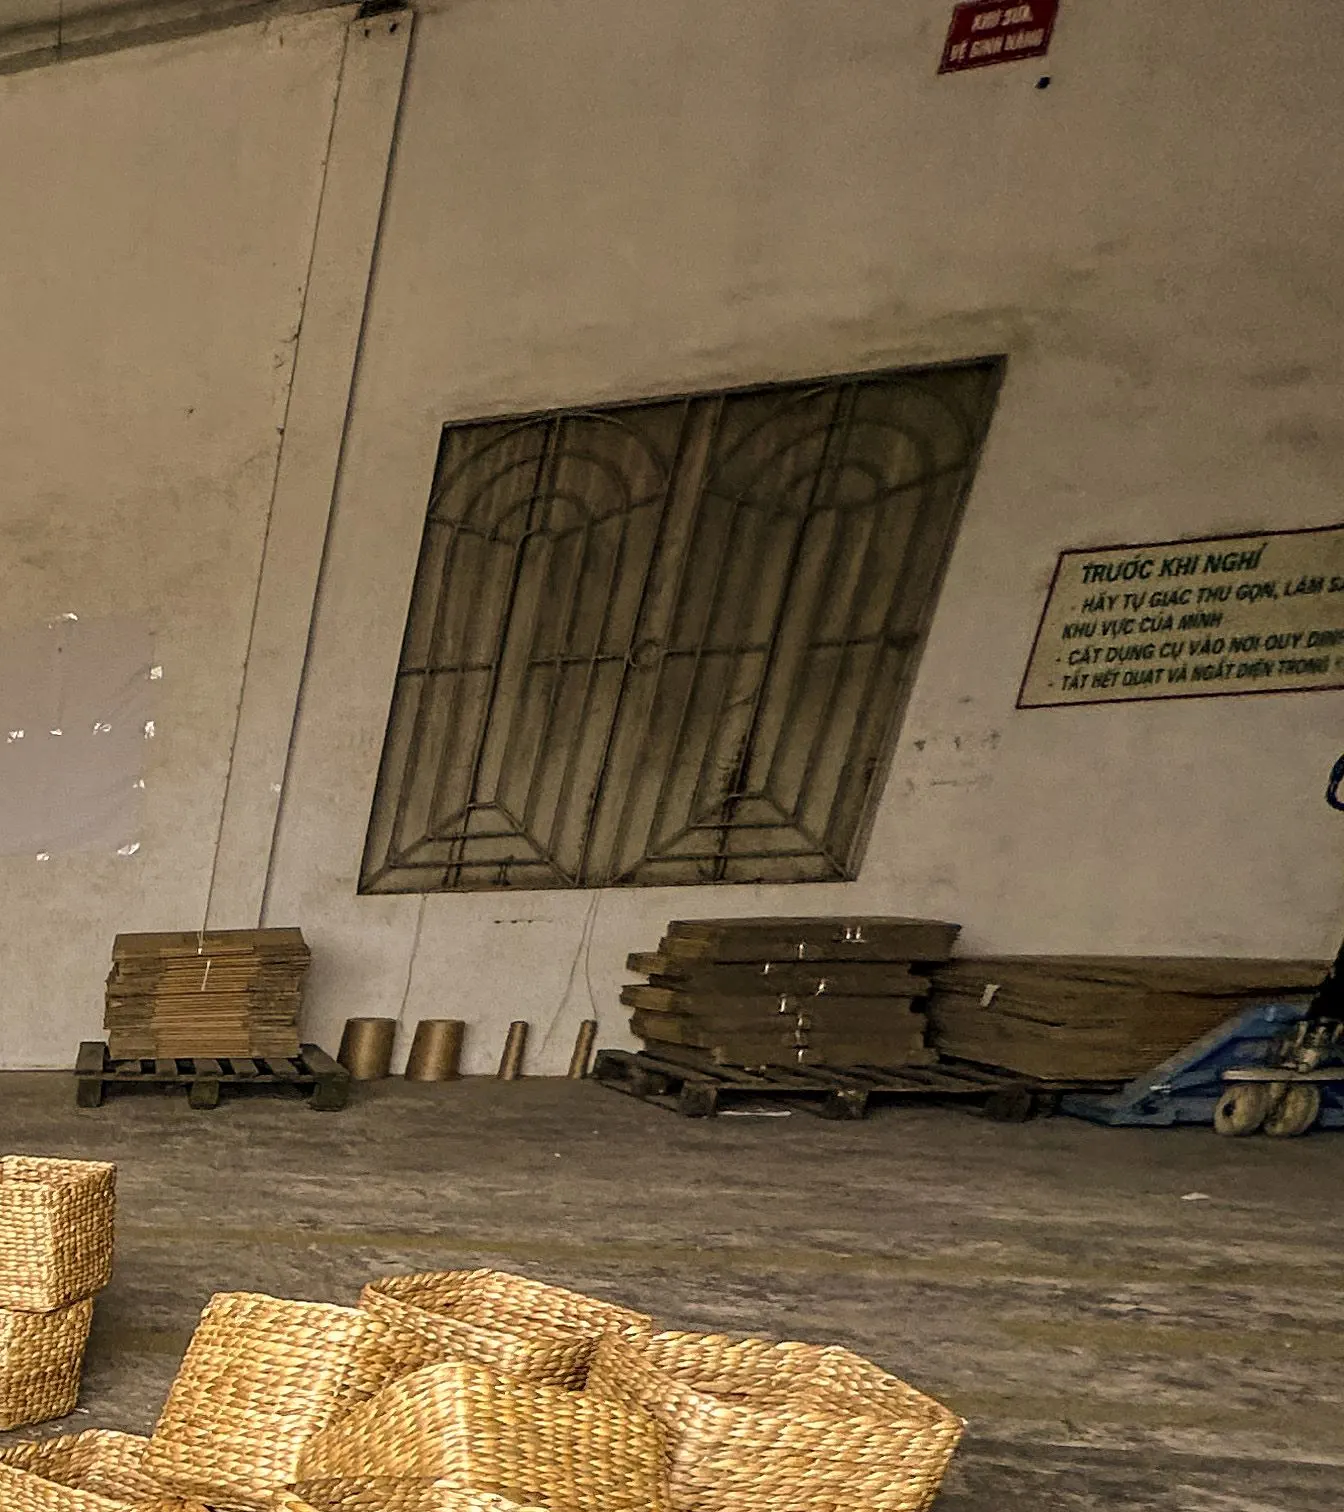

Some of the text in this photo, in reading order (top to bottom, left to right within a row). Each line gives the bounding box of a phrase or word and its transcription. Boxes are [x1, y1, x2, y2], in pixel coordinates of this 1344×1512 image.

[1158, 554, 1200, 578] KHI
[1196, 585, 1232, 603] THU
[1062, 620, 1097, 640] KHU
